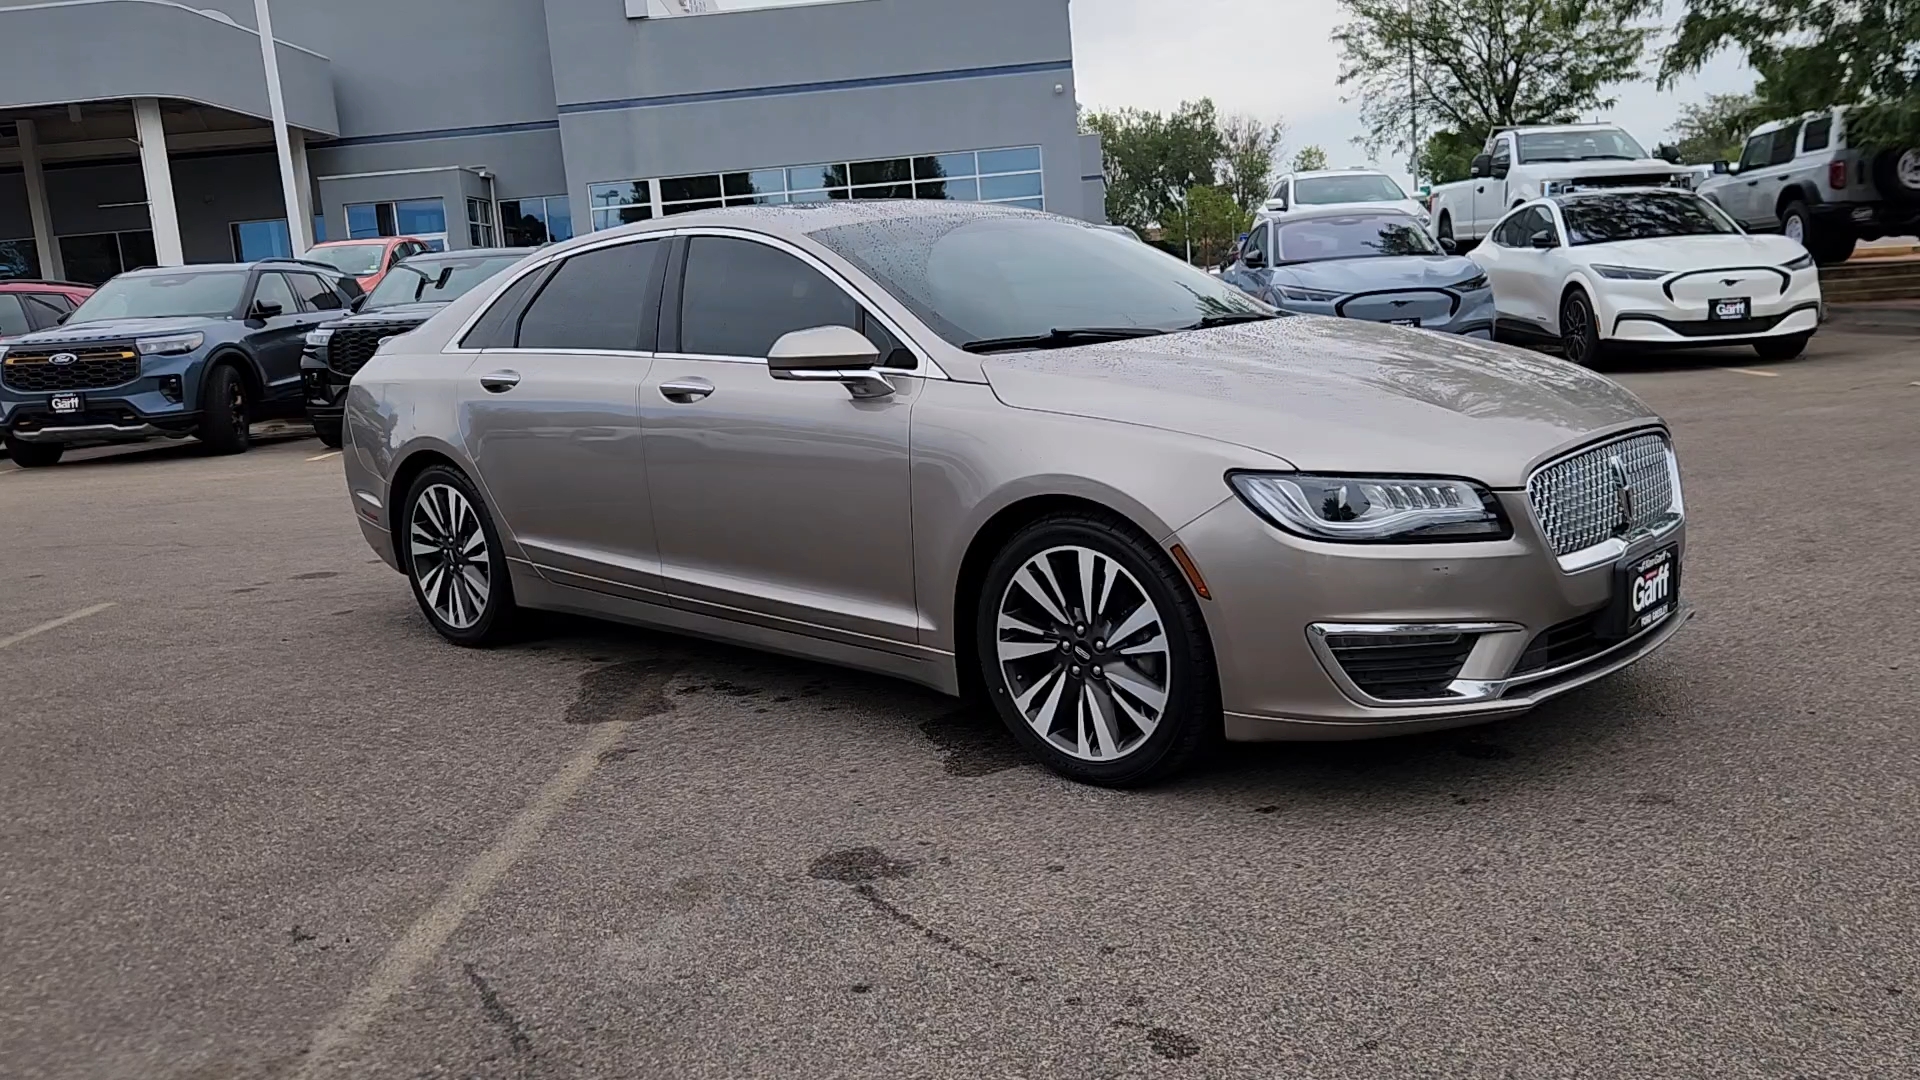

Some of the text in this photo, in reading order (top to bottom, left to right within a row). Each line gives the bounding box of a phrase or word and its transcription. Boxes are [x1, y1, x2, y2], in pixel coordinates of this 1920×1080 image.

[1716, 302, 1746, 315] Garff
[52, 397, 79, 409] Garff
[1633, 562, 1670, 612] Garff
